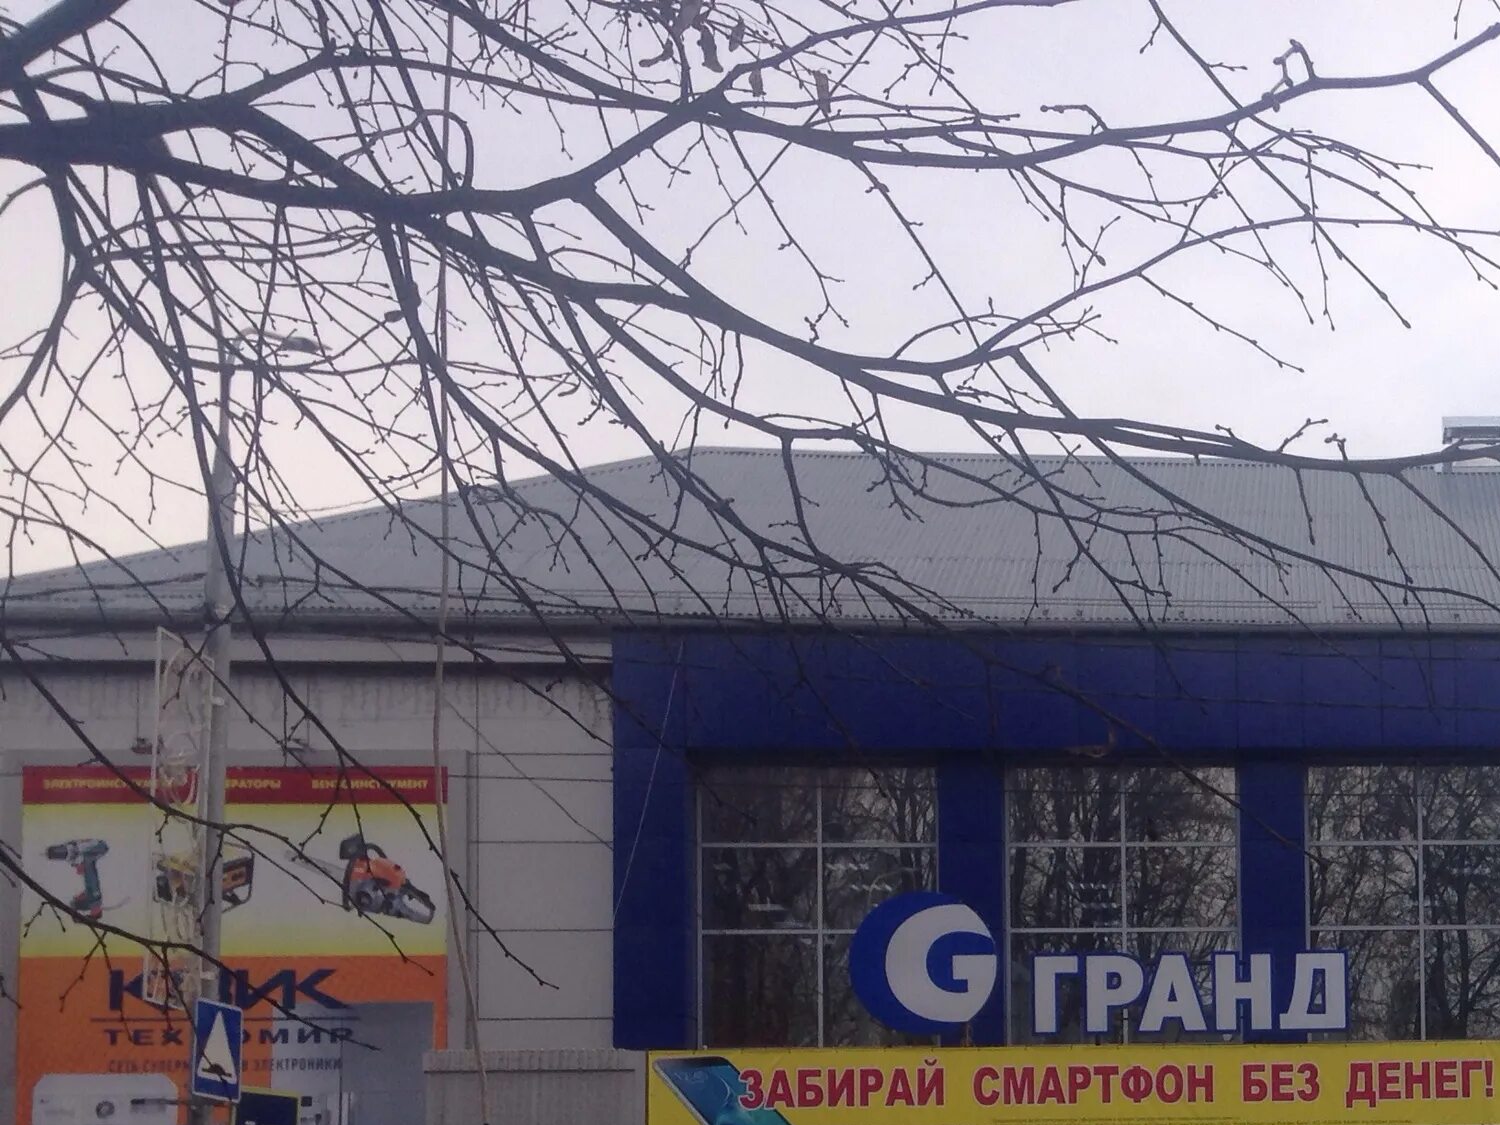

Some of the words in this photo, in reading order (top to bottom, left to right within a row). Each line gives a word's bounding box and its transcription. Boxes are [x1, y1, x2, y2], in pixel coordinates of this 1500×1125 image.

[110, 969, 350, 1012] КИК
[1032, 951, 1349, 1035] ГРАНД
[103, 1028, 354, 1047] ТЕХМИР
[738, 1058, 945, 1110] ЗАБИРАЙ
[972, 1064, 1214, 1107] СМАРТФОН
[1241, 1062, 1320, 1103] БЕЗ
[1345, 1060, 1494, 1109] ДЕНЕГ!
